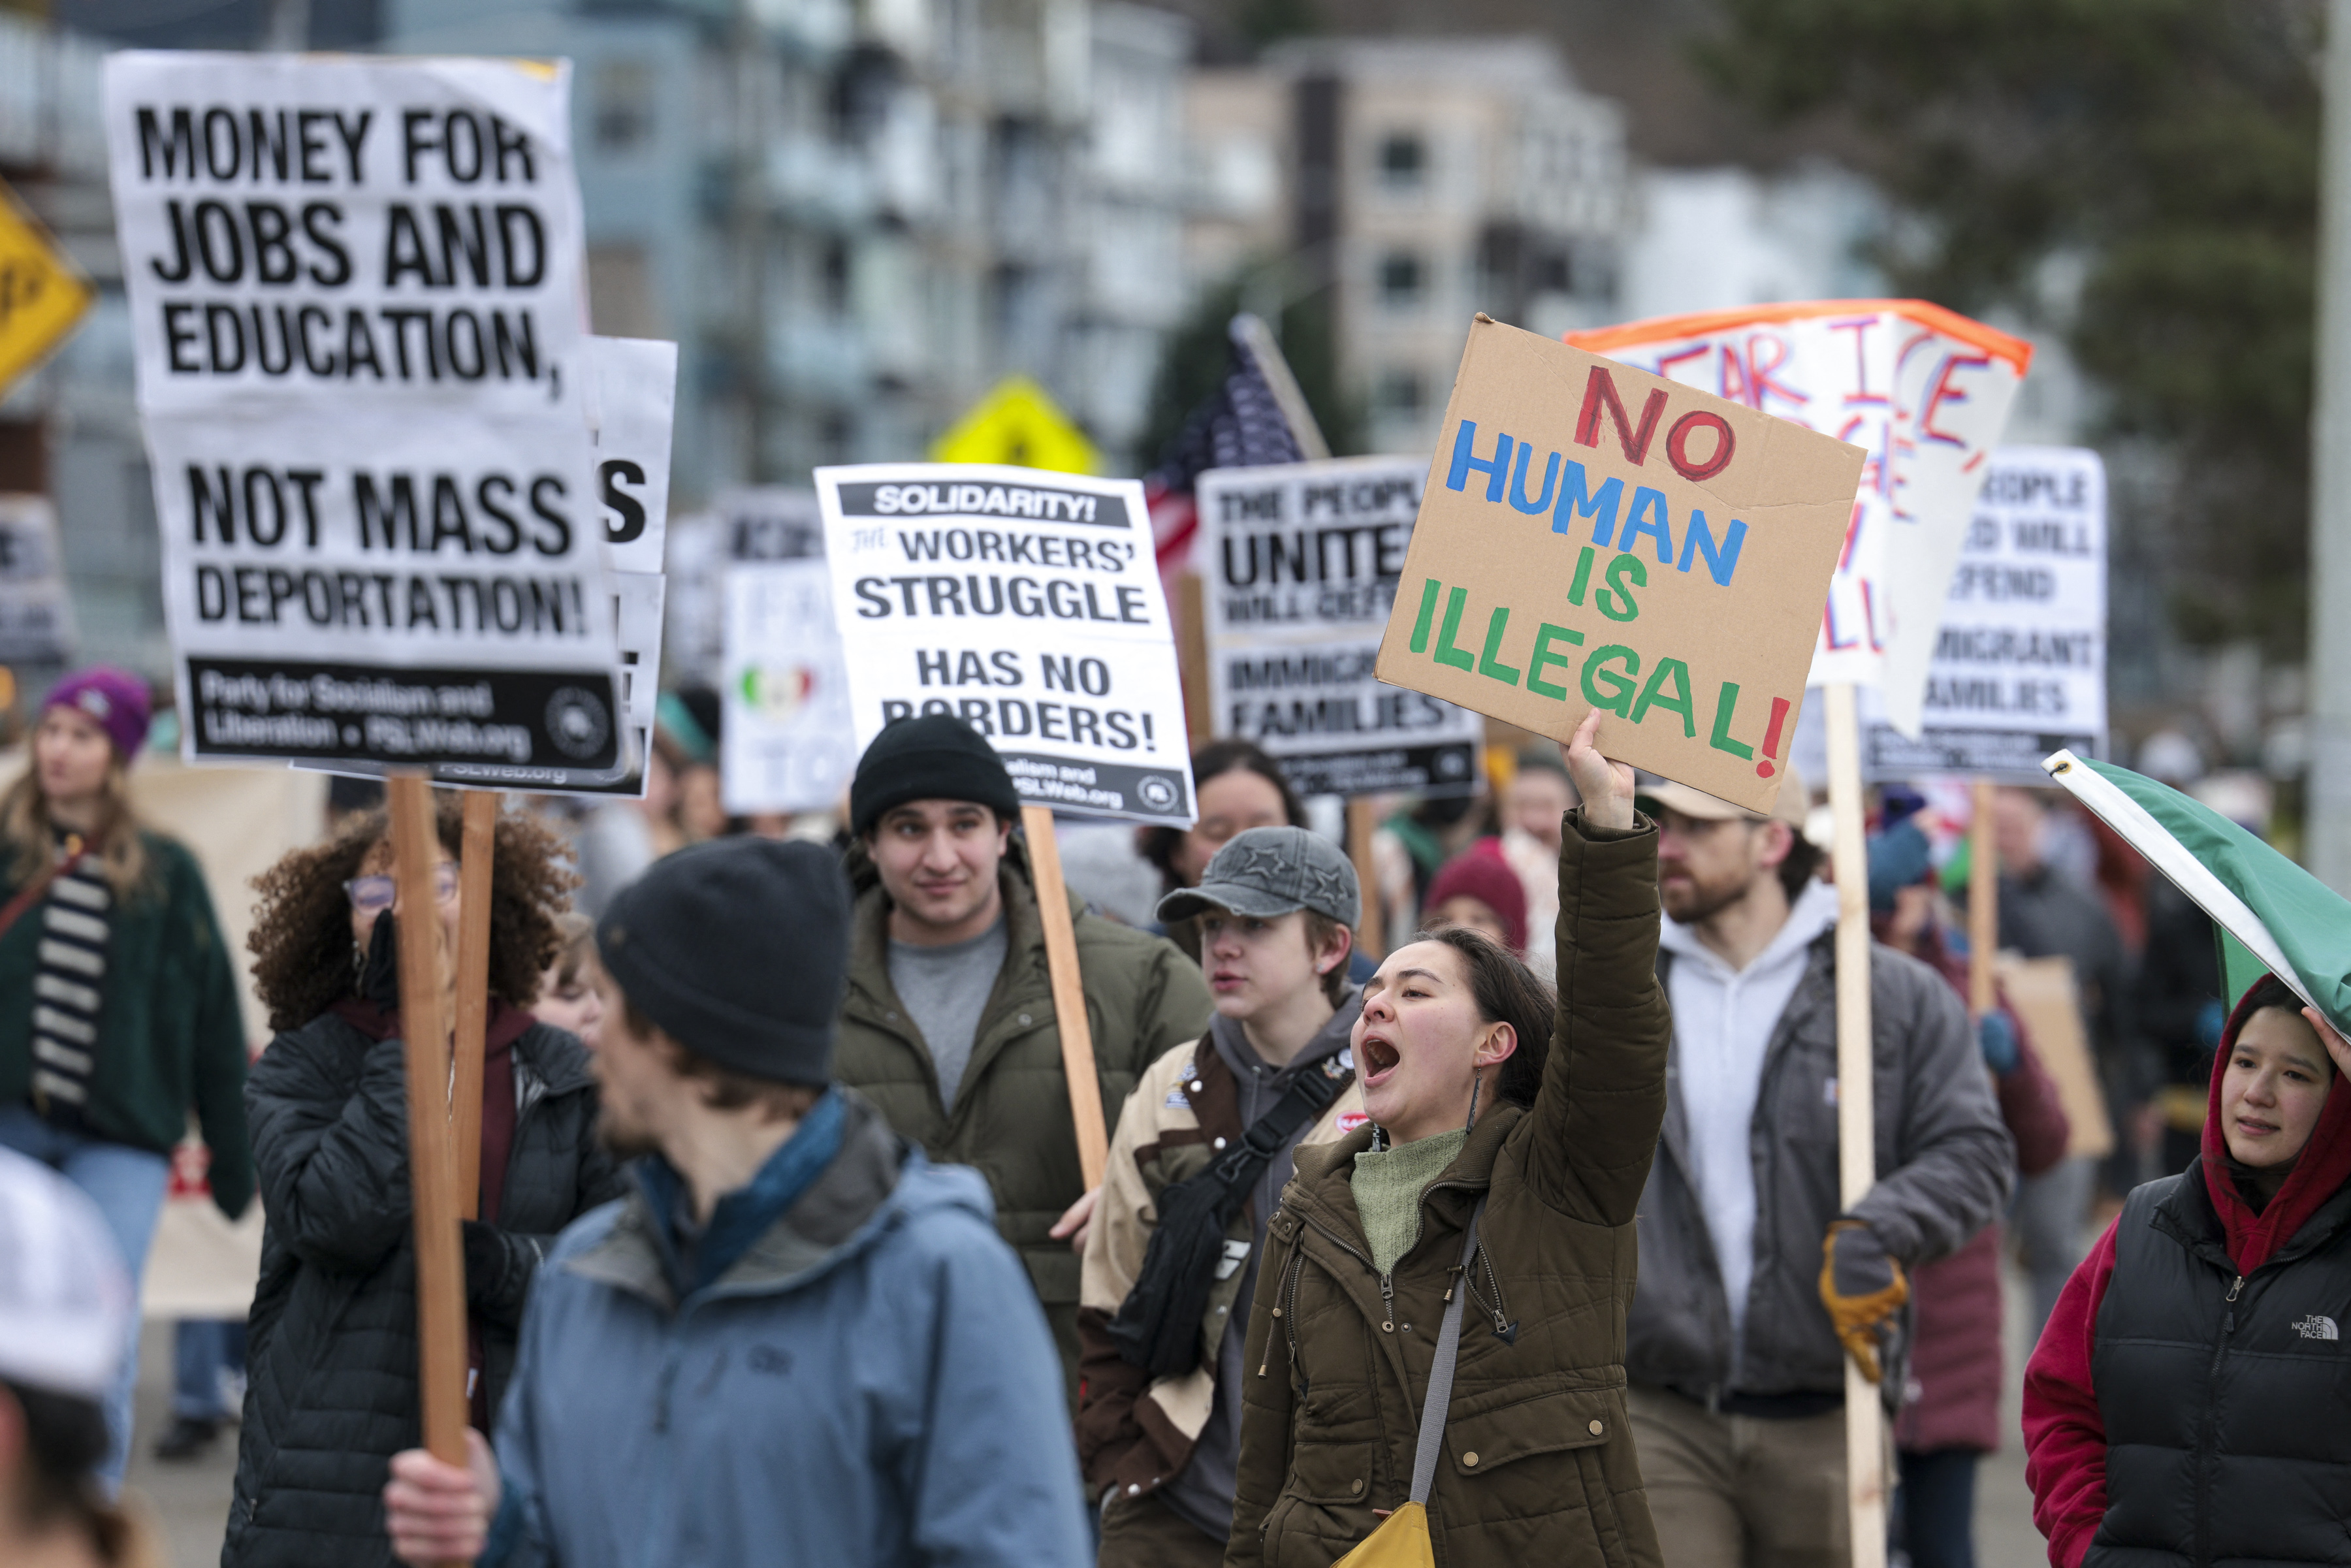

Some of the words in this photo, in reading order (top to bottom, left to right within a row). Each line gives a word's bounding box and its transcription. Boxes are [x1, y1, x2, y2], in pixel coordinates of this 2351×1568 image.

[136, 106, 372, 184] MONEY
[402, 108, 537, 184] FOR
[152, 200, 354, 287] JOBS
[385, 203, 547, 289] AND
[163, 302, 563, 401] EDUCATION,
[1573, 364, 1736, 483] NO
[186, 464, 324, 547] NOT
[353, 472, 574, 556] MASS
[874, 485, 1097, 522] SOLIDARITY!
[1219, 487, 1282, 520] THE
[1303, 479, 1420, 514] PEOPL
[1445, 419, 1749, 587] HUMAN
[1223, 525, 1408, 587] UNITE
[197, 564, 589, 637] DEPORTATION!
[855, 575, 1151, 625] STRUGGLE
[1567, 546, 1648, 622] IS
[199, 669, 270, 714] Party
[270, 672, 310, 710] for
[310, 673, 437, 714] Socialism
[436, 680, 495, 718] and
[916, 650, 1024, 686] HAS
[1041, 654, 1110, 696] NO
[1409, 578, 1791, 779] ILLEGAL!
[203, 707, 339, 749] Liberation
[1232, 695, 1445, 736] FAMILIES
[1058, 765, 1097, 785] and
[2291, 1322, 2323, 1332] NORTH
[2300, 1330, 2323, 1339] FACE
[2306, 1315, 2323, 1324] THE
